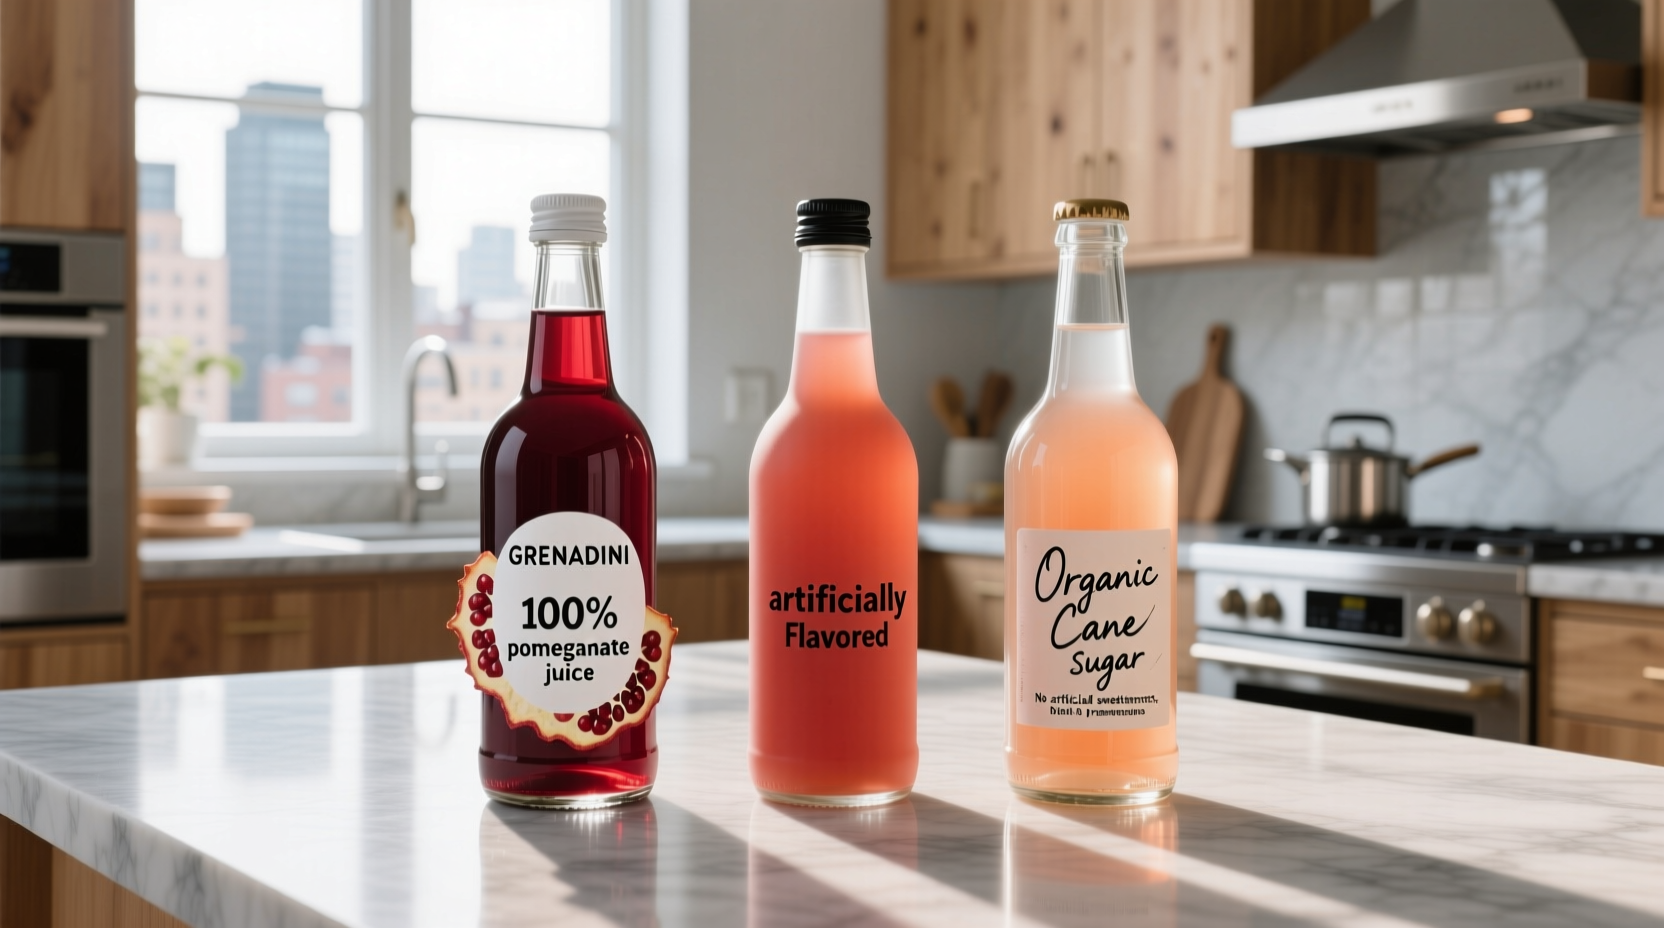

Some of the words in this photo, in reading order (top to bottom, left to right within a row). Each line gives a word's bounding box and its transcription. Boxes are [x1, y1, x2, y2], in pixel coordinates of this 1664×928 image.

[508, 544, 629, 566] GRENADINI
[1035, 546, 1158, 614] Organic
[522, 595, 618, 630] 100%
[769, 582, 907, 620] artificially
[785, 621, 889, 649] Flavored
[1051, 602, 1156, 650] Cane
[508, 639, 630, 661] pomeganate
[543, 663, 594, 686] juice
[1035, 692, 1047, 703] No
